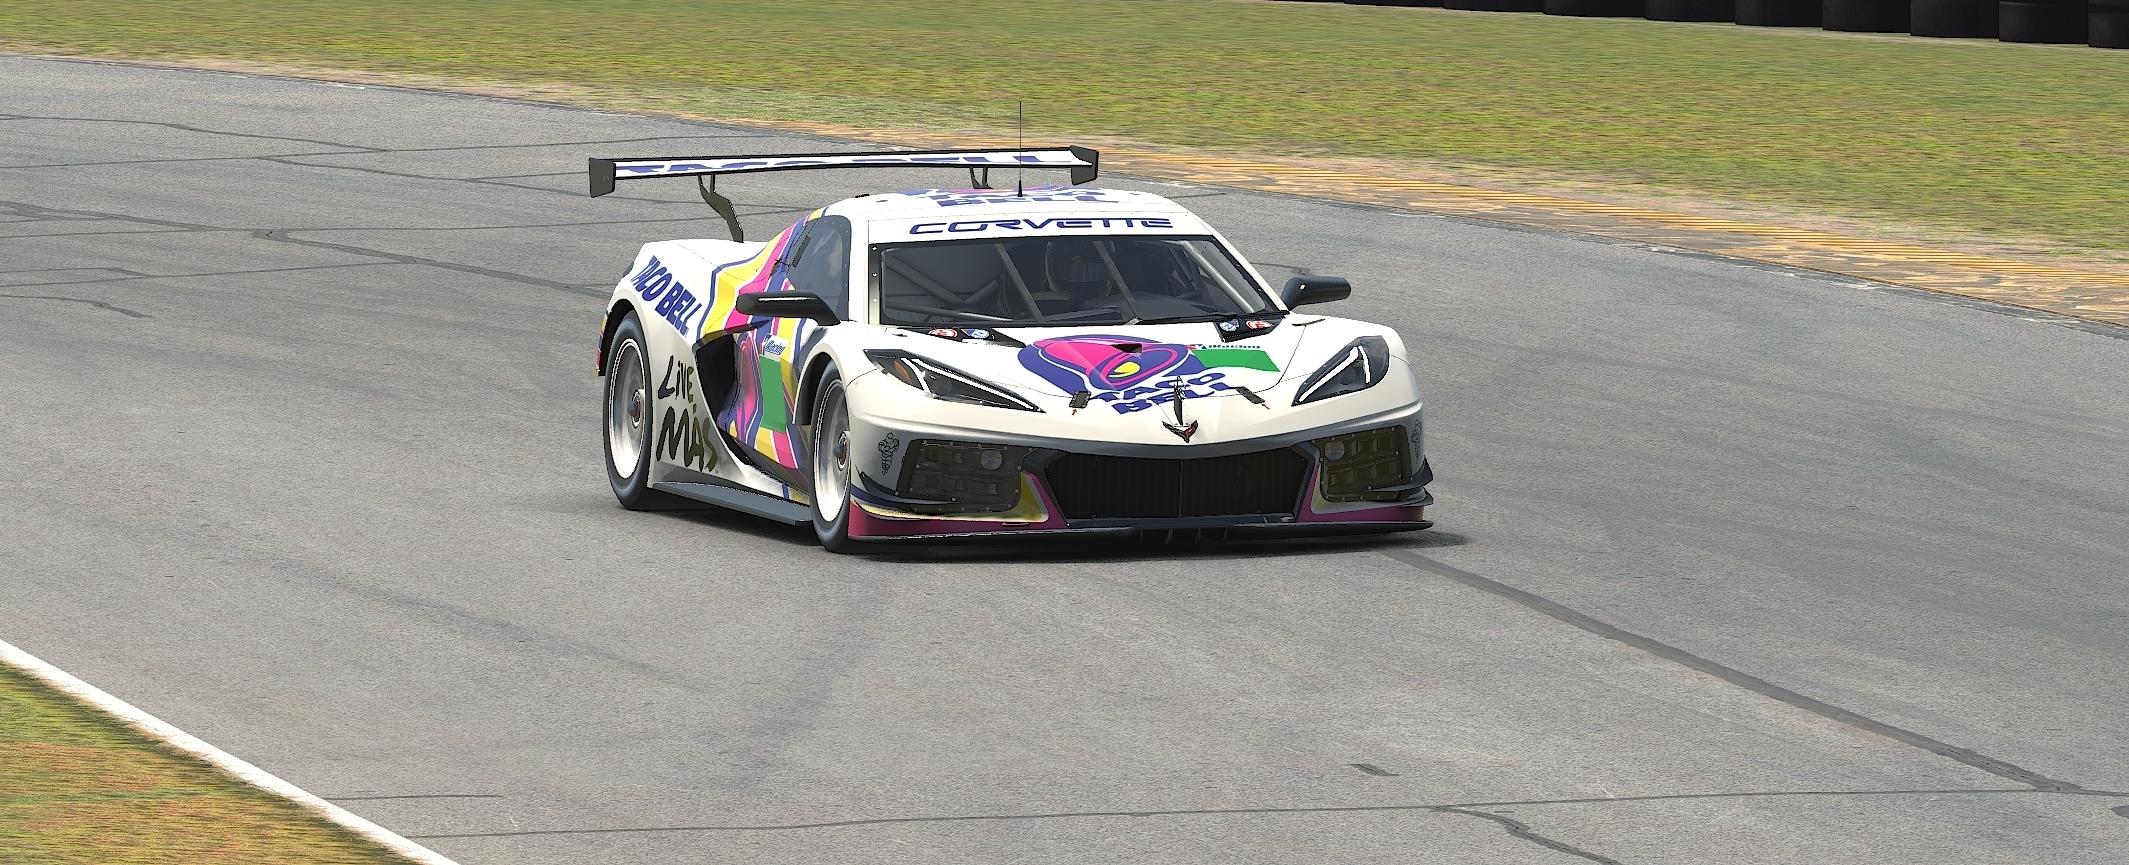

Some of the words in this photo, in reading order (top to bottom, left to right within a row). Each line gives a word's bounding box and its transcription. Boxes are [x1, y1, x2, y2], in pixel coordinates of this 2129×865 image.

[909, 218, 1173, 235] CORVETTE
[630, 254, 673, 302] TACO
[654, 281, 703, 337] BELL
[1089, 372, 1226, 402] TACO
[1111, 382, 1236, 415] BELL
